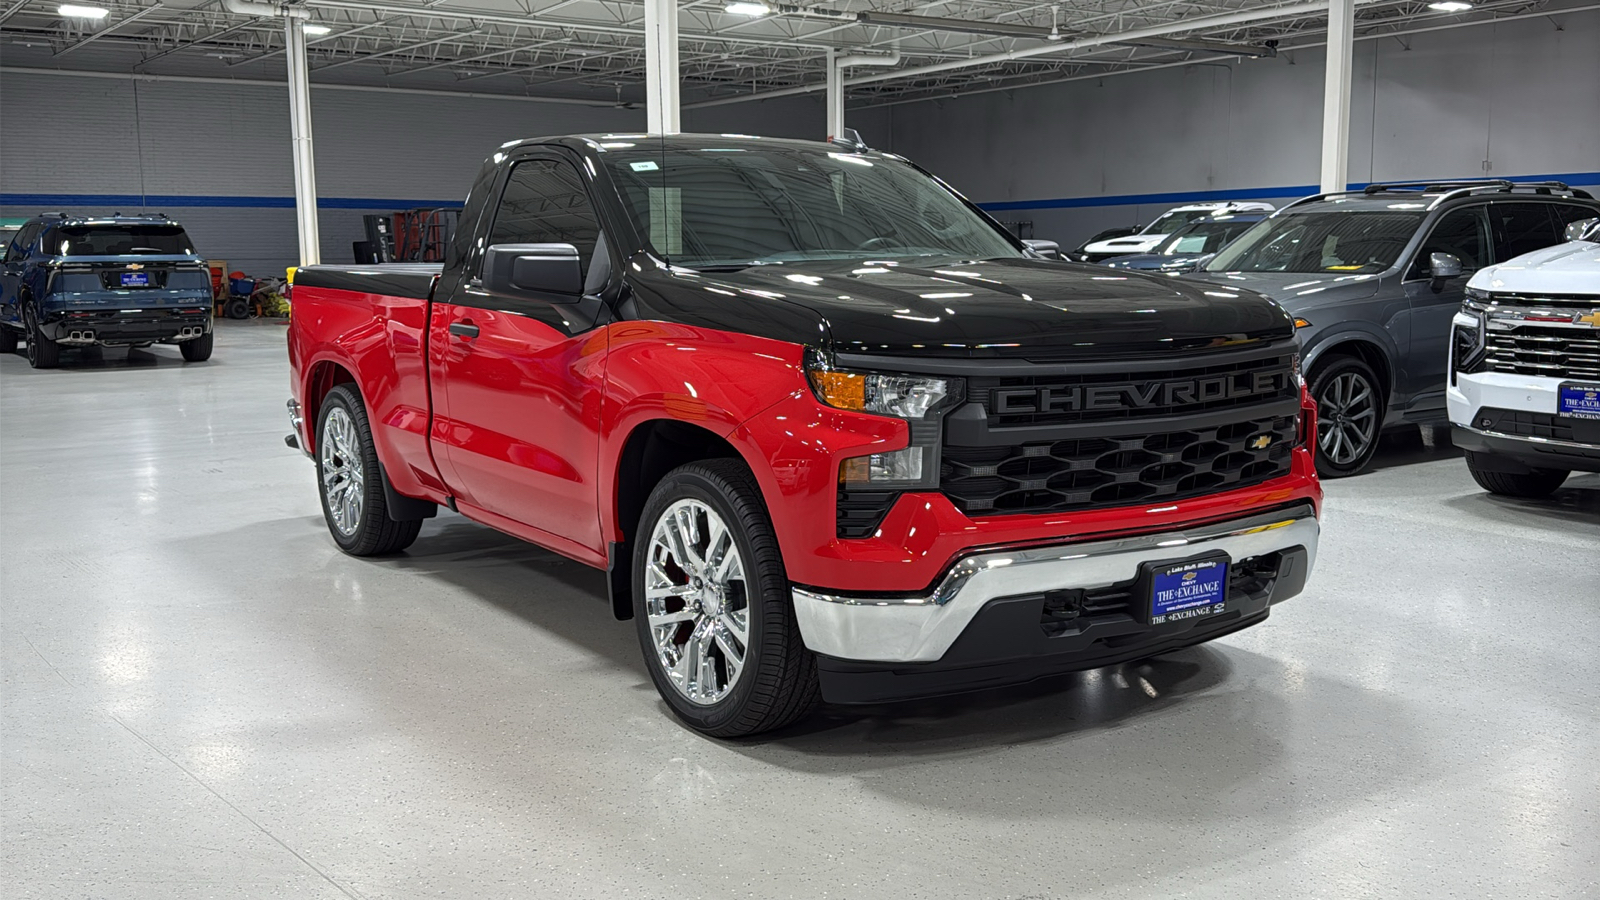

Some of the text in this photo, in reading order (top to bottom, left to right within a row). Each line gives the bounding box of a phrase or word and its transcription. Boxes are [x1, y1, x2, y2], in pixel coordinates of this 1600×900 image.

[996, 371, 1292, 413] CHEVROLET
[1565, 398, 1579, 406] THE
[1582, 400, 1600, 408] EXCH
[1157, 581, 1219, 602] THE EXCHANGE
[1152, 607, 1211, 624] THE EXCHANGE
